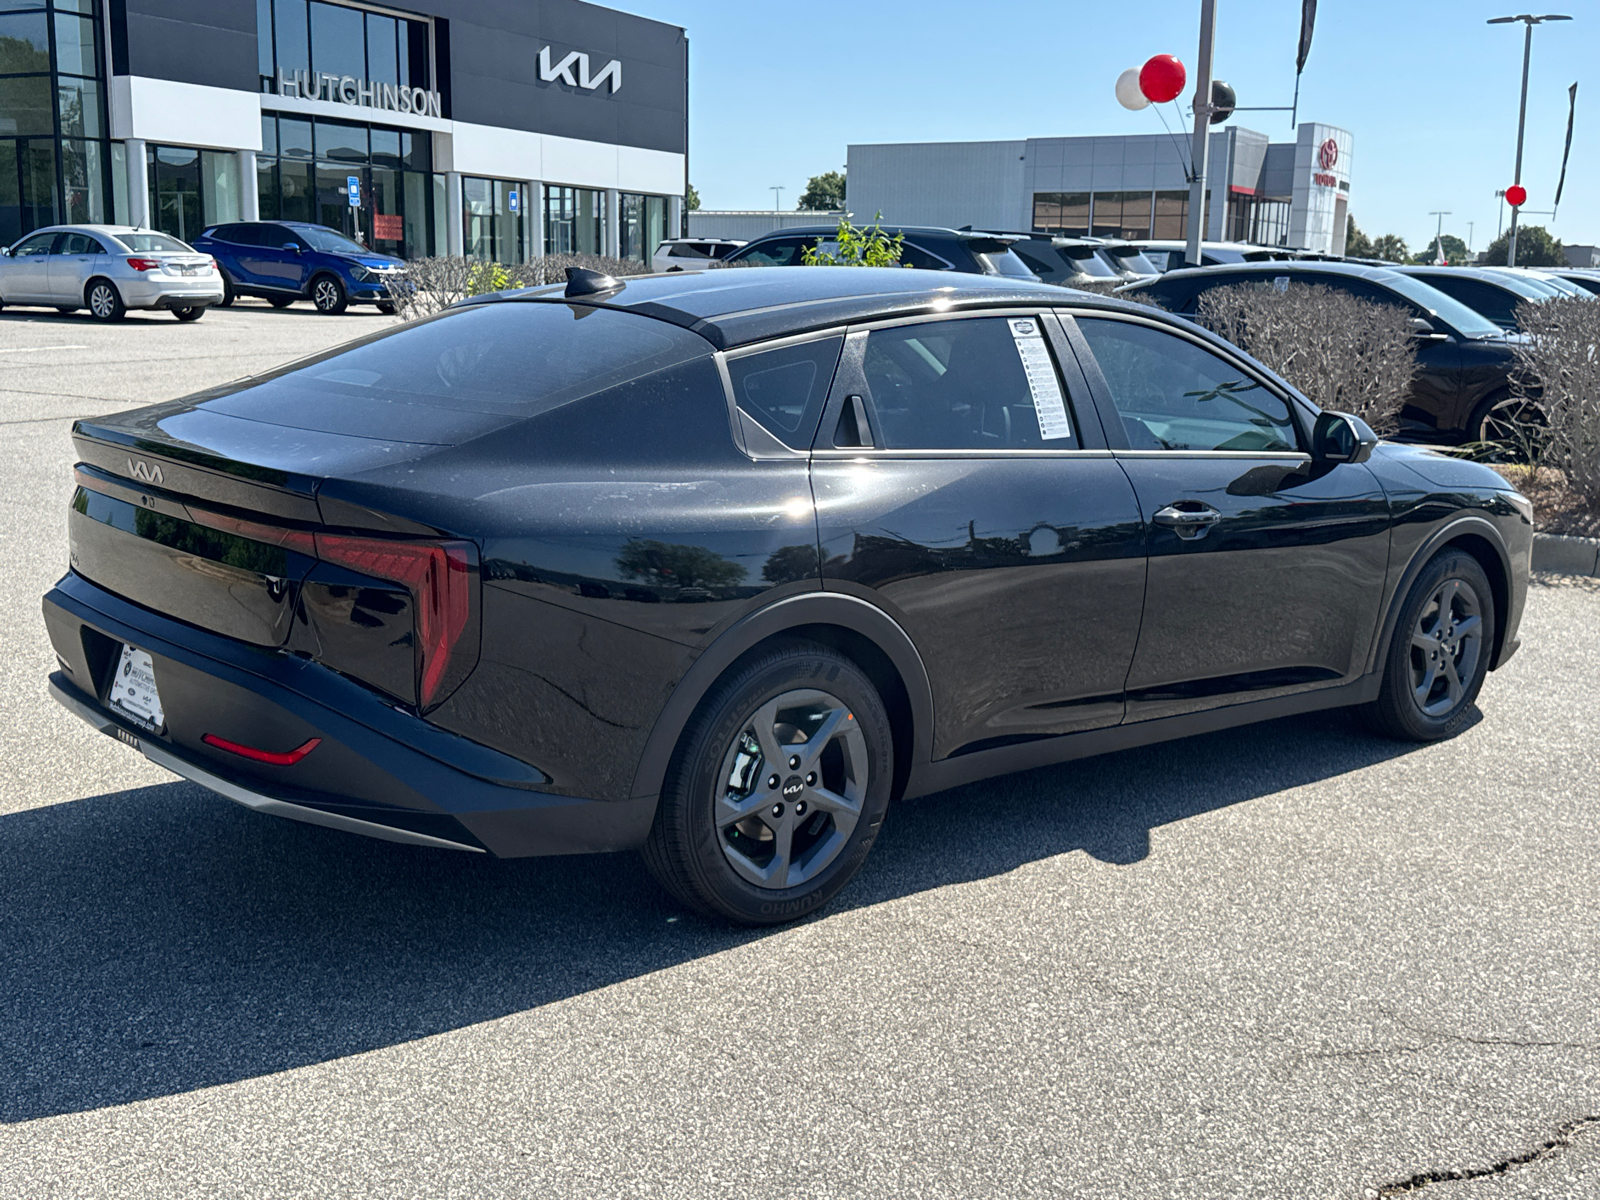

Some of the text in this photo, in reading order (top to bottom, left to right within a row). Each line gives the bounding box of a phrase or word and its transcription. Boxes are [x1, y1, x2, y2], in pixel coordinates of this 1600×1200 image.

[277, 66, 441, 118] HUTCHINSON
[704, 699, 748, 774] SOLUS
[760, 889, 824, 914] KUMHO
